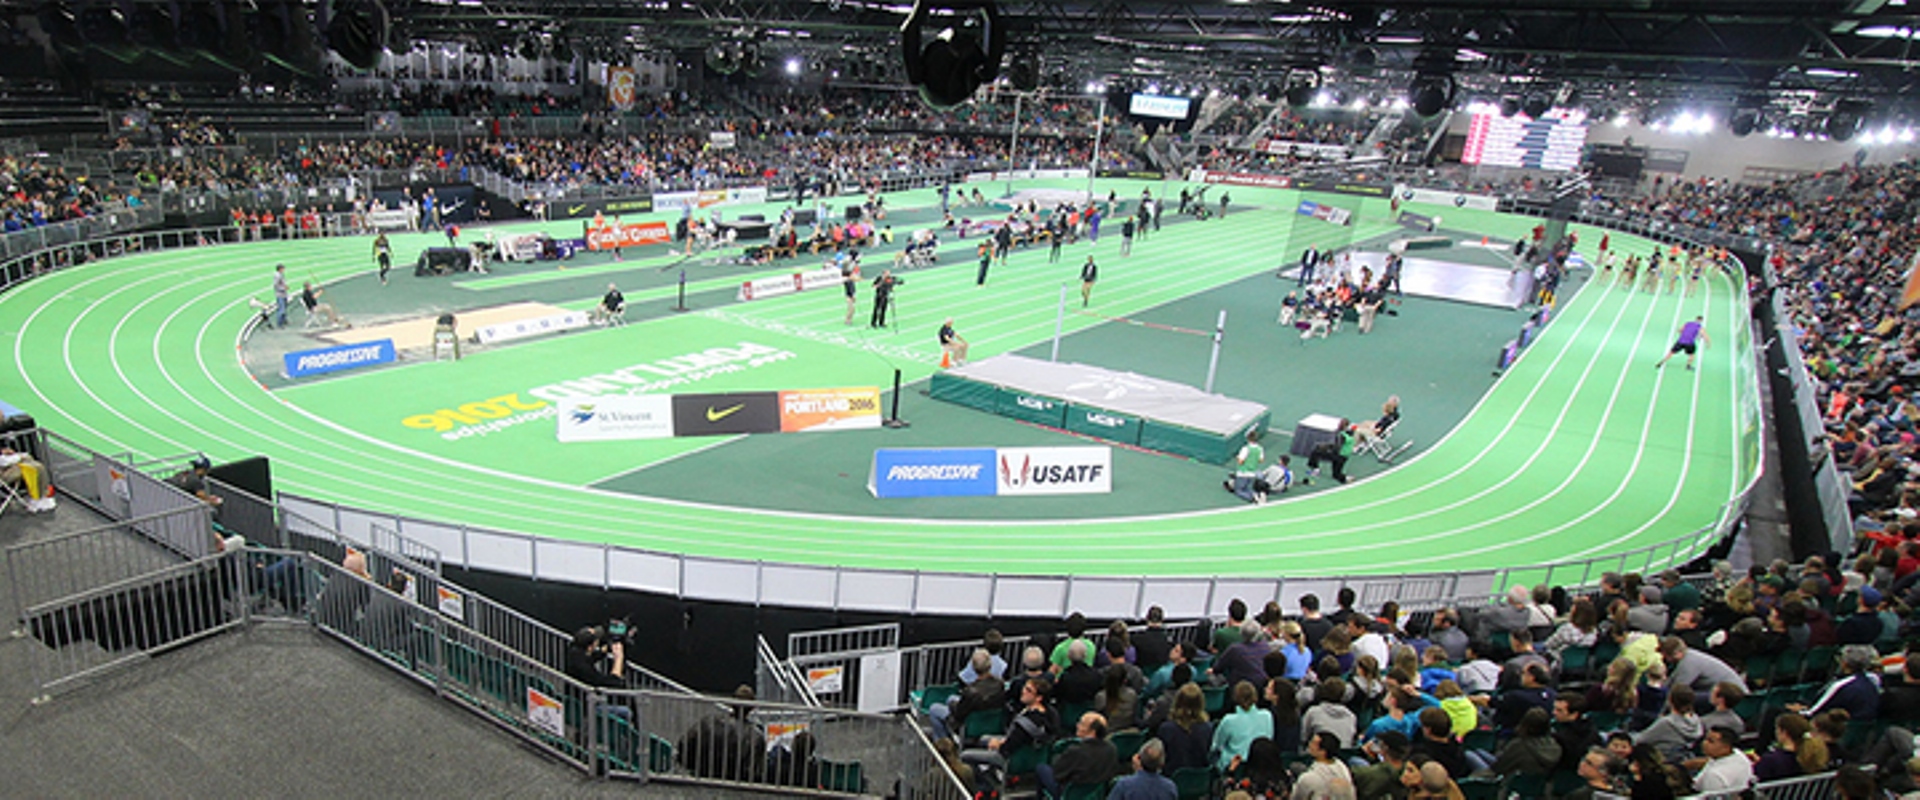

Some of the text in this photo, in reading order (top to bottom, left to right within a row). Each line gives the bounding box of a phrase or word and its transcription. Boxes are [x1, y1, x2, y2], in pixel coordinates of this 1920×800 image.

[297, 345, 382, 371] PROGRESSIVE
[401, 393, 546, 432] 2016
[886, 463, 1104, 484] PROGRESSIVE USATF
